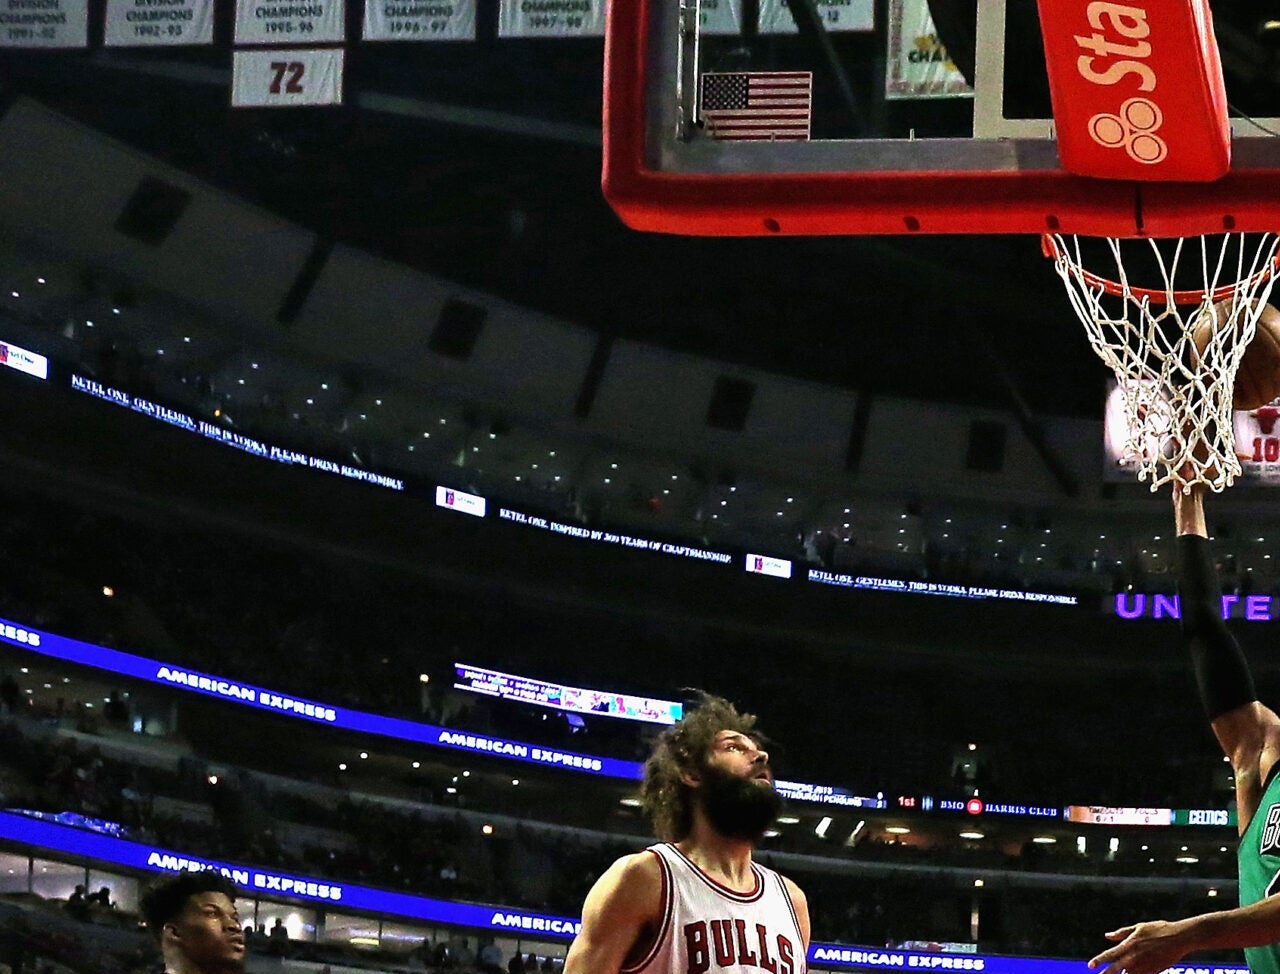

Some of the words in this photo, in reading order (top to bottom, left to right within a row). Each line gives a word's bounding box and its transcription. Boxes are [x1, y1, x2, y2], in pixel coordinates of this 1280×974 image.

[125, 9, 194, 22] CHAMPIONS
[255, 5, 323, 18] CHAMPIONS
[383, 4, 453, 17] CHAMPIONS
[269, 62, 305, 94] 72
[1252, 437, 1280, 463] 10
[157, 666, 255, 702] AMERICAN
[259, 691, 337, 722] EXPRESS
[438, 731, 528, 758] AMERICAN
[531, 747, 602, 772] EXPRESS
[898, 795, 915, 807] 1st
[940, 799, 964, 810] BMO
[985, 803, 1026, 815] HARRIS
[1028, 804, 1057, 817] CLUB
[1188, 809, 1230, 825] CELTICS
[254, 874, 342, 900] EXPRESS
[814, 948, 905, 967] AMERICAN
[908, 955, 985, 971] EXPRESS
